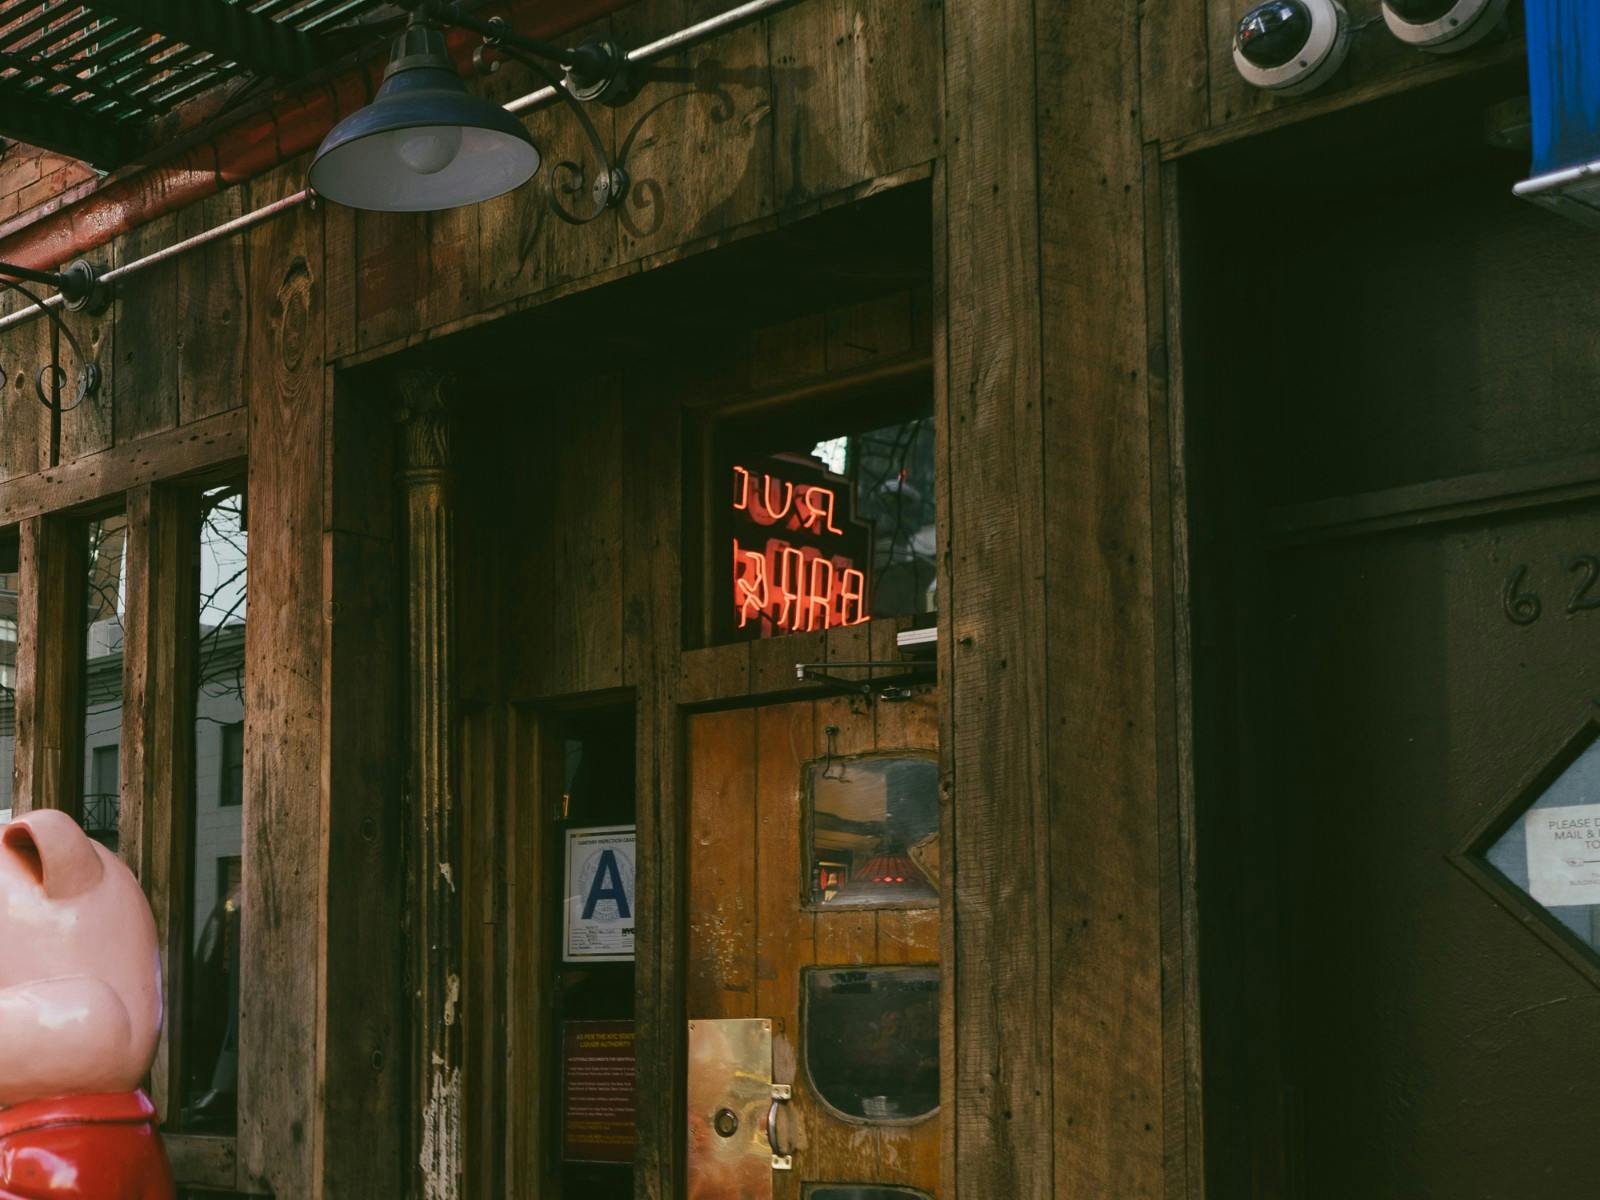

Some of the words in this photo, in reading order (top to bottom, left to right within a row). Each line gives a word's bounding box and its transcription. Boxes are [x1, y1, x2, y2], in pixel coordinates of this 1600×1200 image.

[1548, 818, 1591, 830] PLEASE
[1554, 829, 1584, 841] MAIL
[581, 850, 632, 919] A
